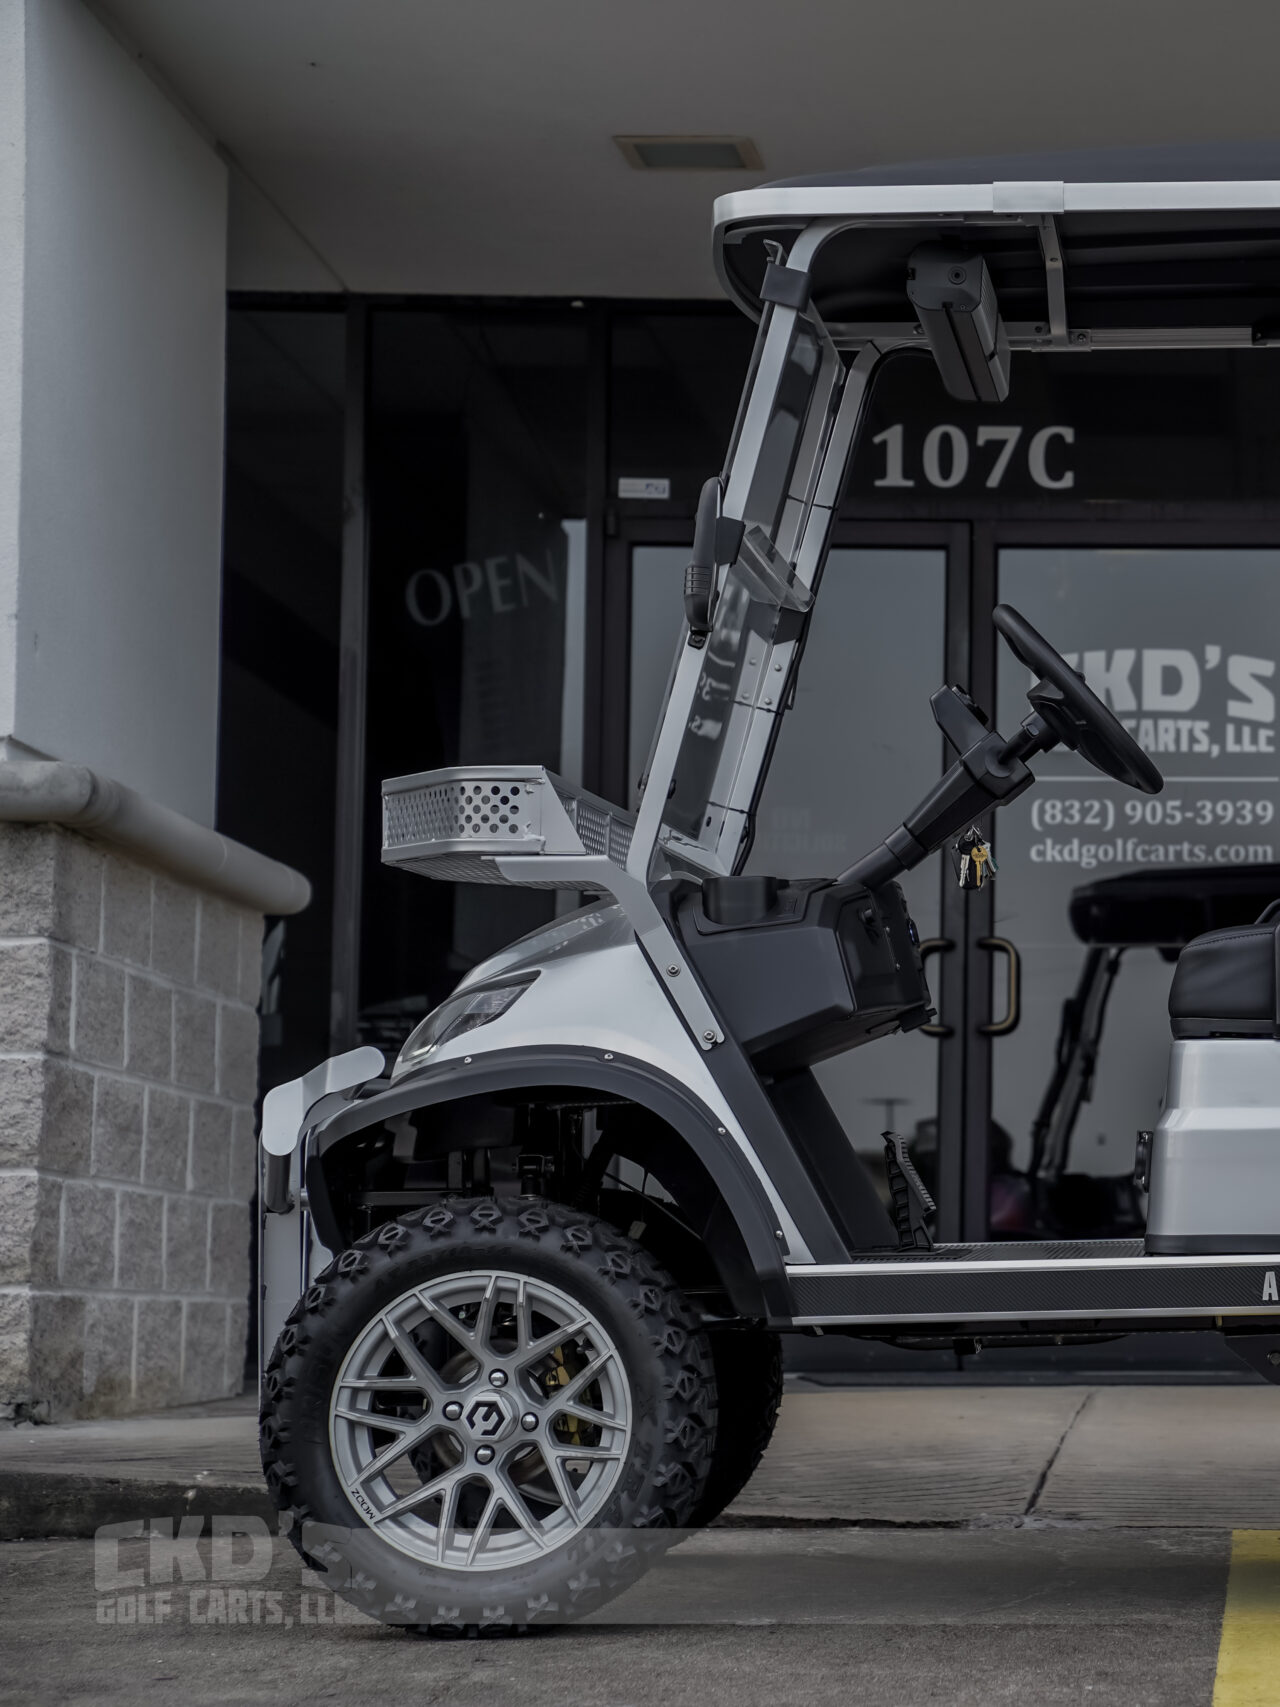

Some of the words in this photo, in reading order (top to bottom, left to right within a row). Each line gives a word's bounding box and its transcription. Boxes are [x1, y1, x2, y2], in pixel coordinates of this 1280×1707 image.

[872, 424, 1075, 489] 107C
[405, 548, 560, 626] OPEN
[1226, 723, 1275, 753] LLC
[1031, 799, 1115, 831] (832)
[1125, 799, 1274, 825] 905-3939
[1030, 838, 1274, 869] ckdgolfcarts.com
[351, 1488, 376, 1520] MODZ
